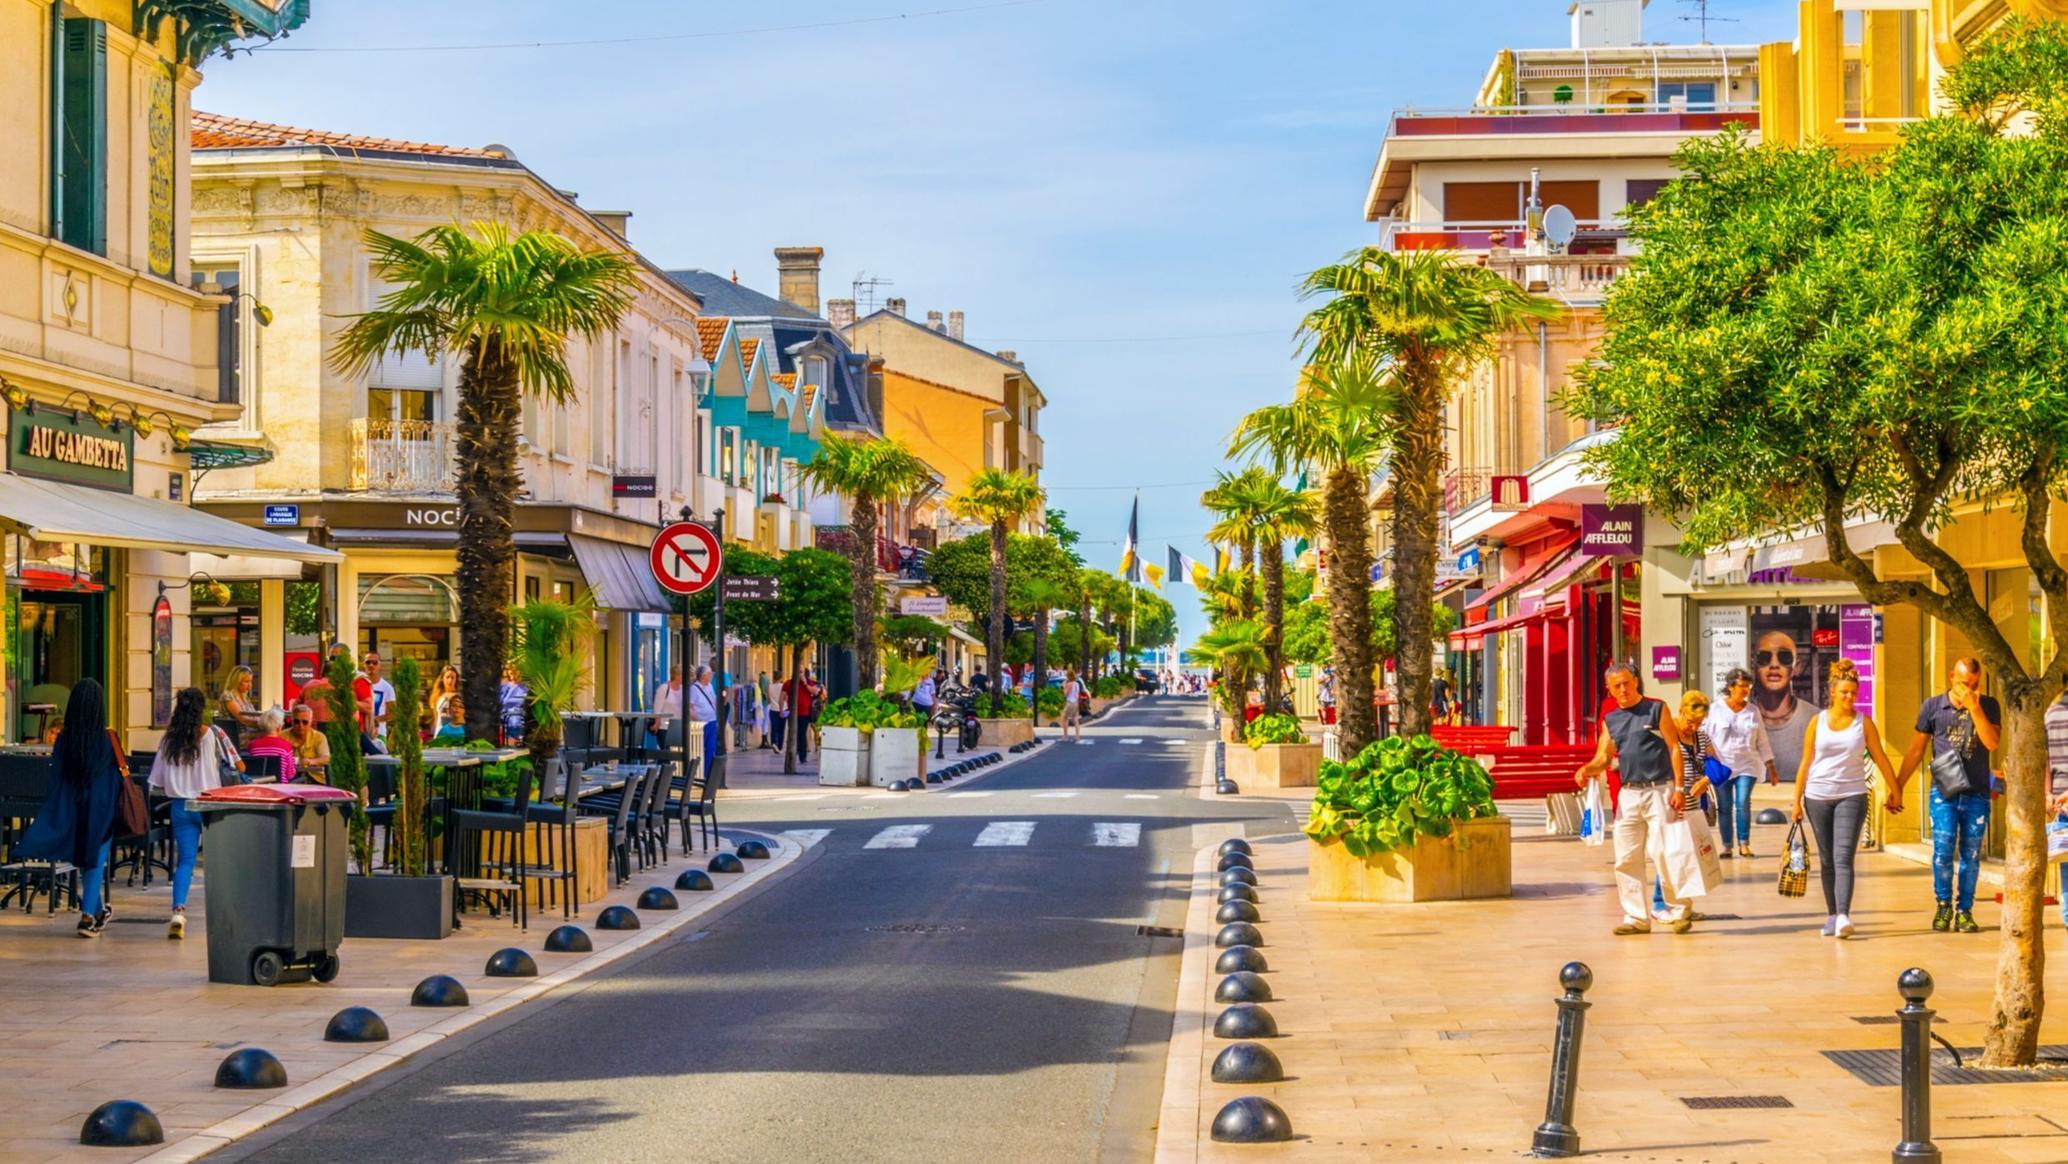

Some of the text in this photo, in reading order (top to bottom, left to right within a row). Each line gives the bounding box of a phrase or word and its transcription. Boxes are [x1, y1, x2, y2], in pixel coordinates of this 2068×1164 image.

[29, 424, 128, 472] AU GAMBETTA
[1601, 521, 1632, 532] ALAIN
[1583, 533, 1632, 544] AFFLELOU
[1660, 656, 1676, 664] ALAIN
[1653, 664, 1677, 672] AFFLELOU
